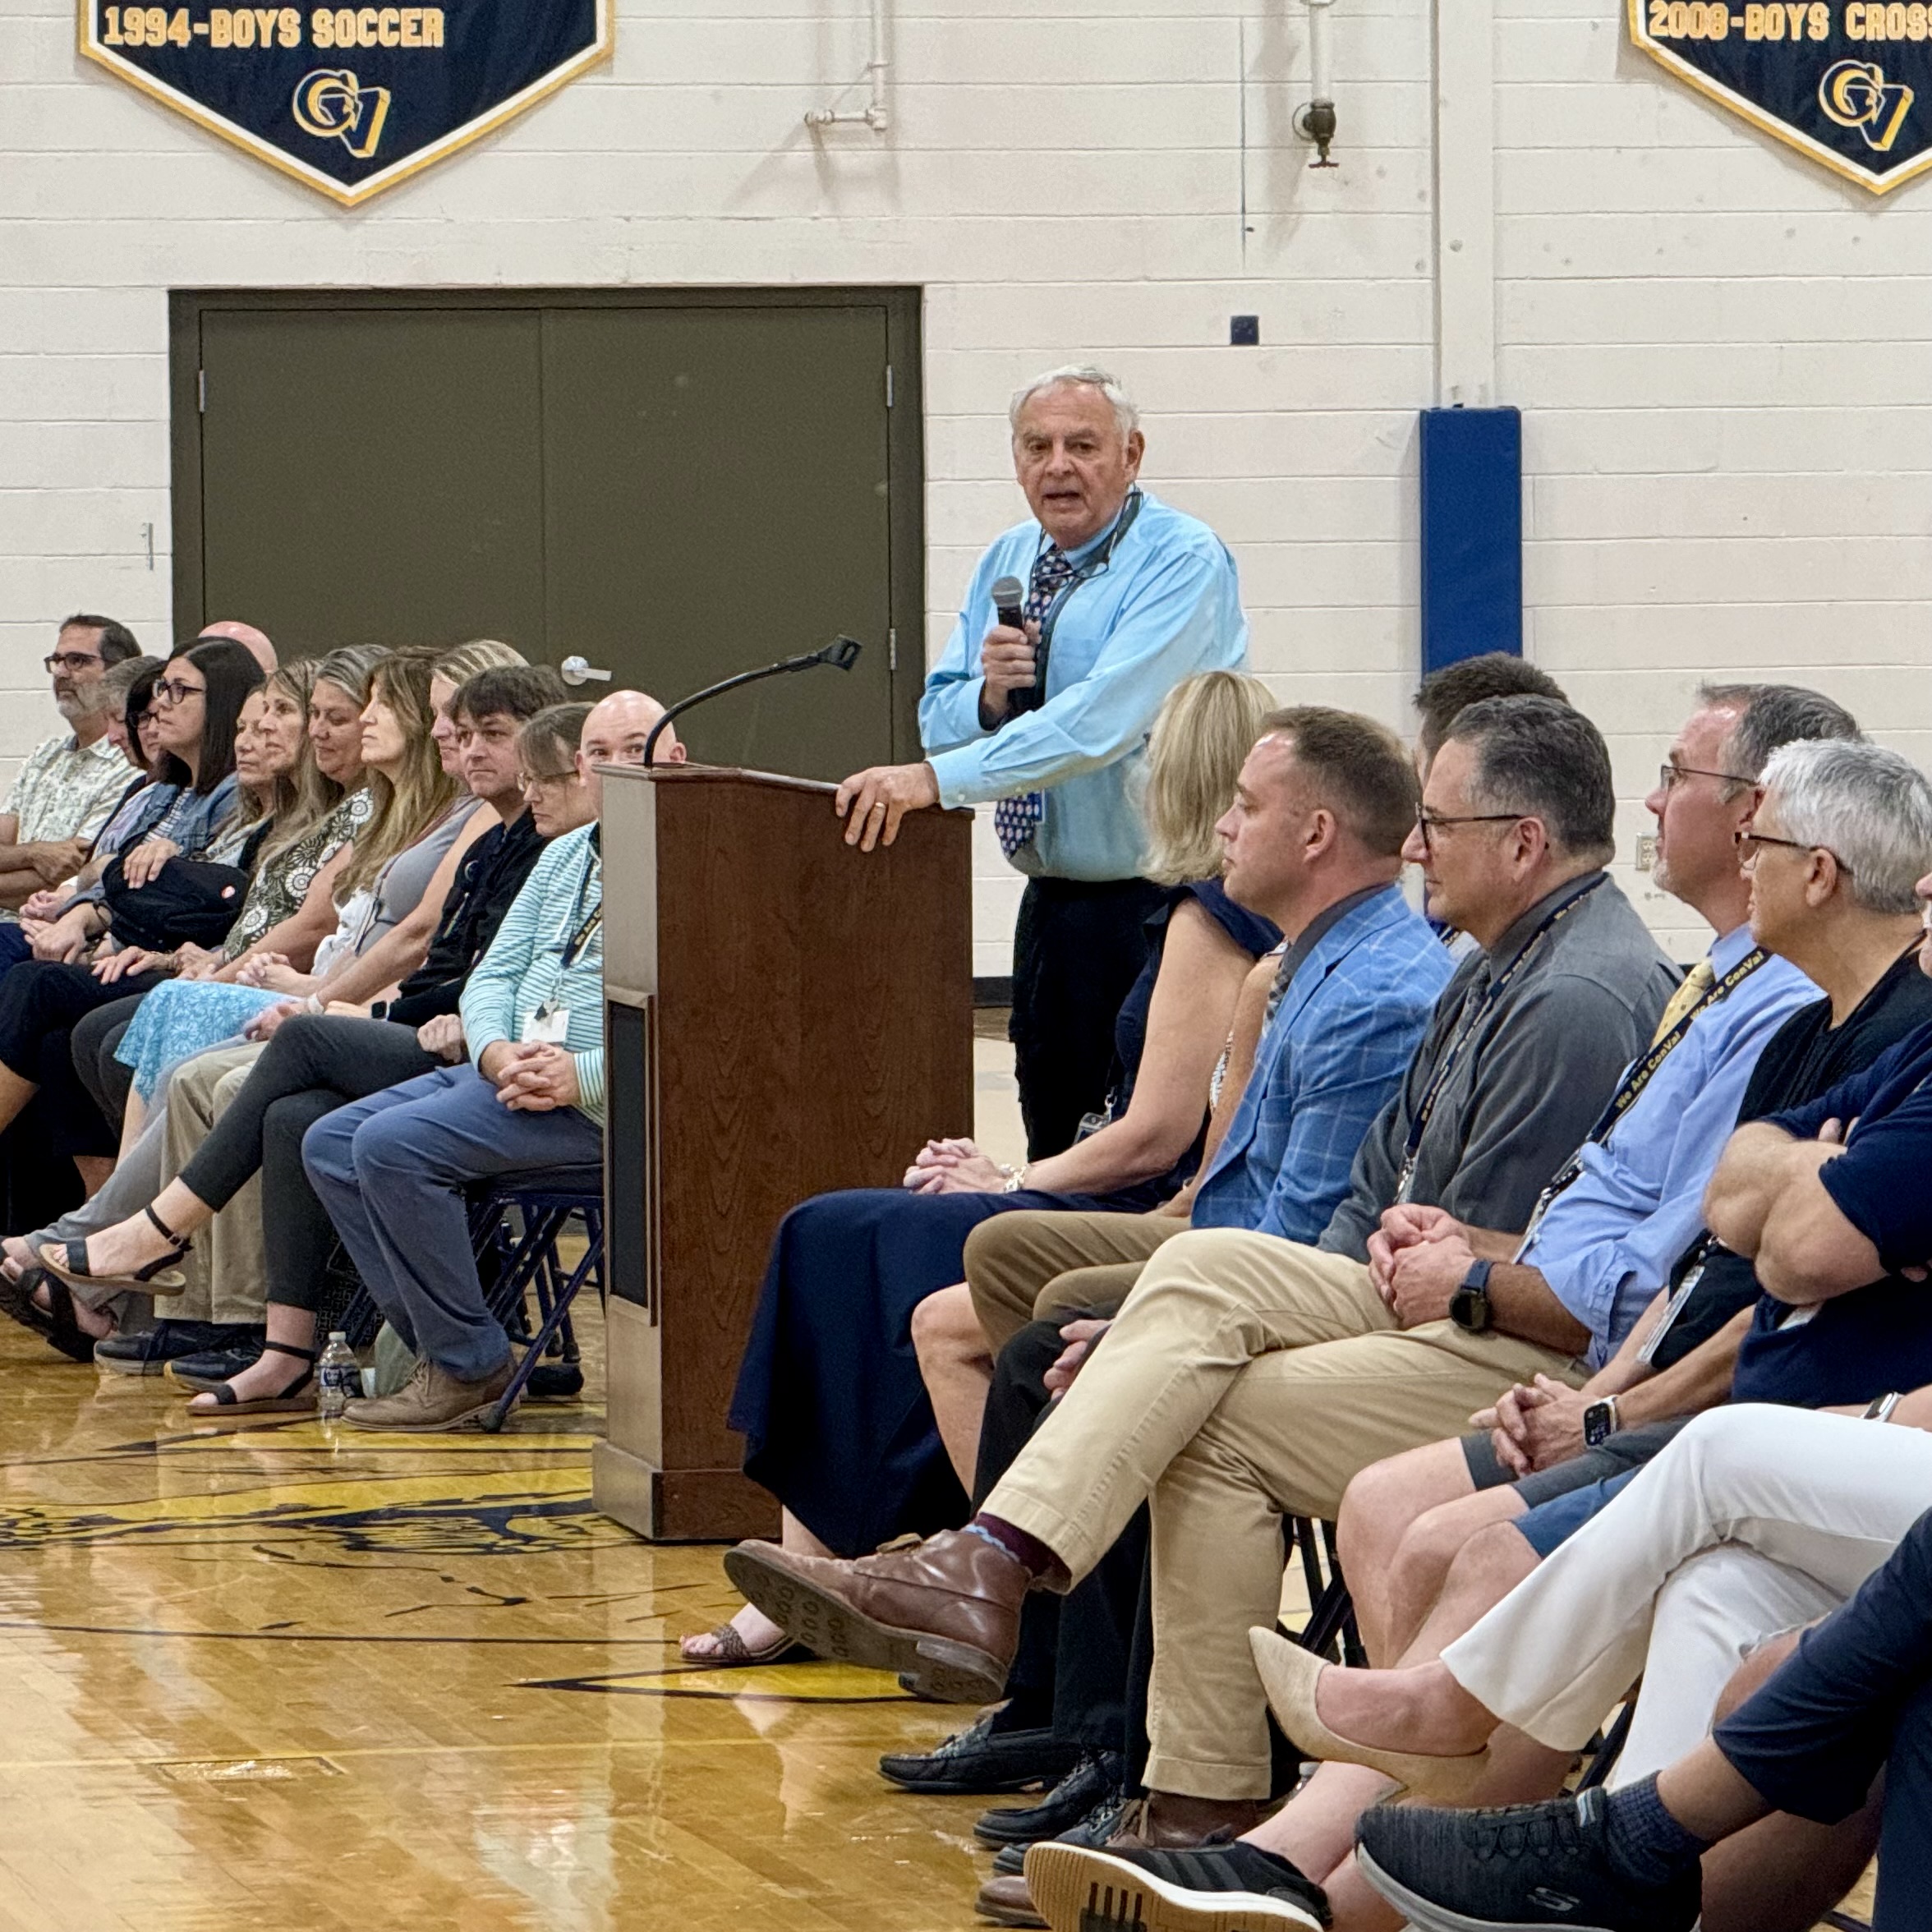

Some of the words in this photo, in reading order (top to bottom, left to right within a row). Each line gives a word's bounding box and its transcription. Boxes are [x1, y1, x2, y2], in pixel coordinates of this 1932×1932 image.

[104, 7, 301, 48] 1994-BOYS
[312, 7, 444, 48] SOCCER
[1649, 0, 1830, 41] 2008-BOYS
[1846, 2, 1932, 41] CROS
[1725, 950, 1765, 987] ConVal
[1648, 1030, 1681, 1070] ConVal
